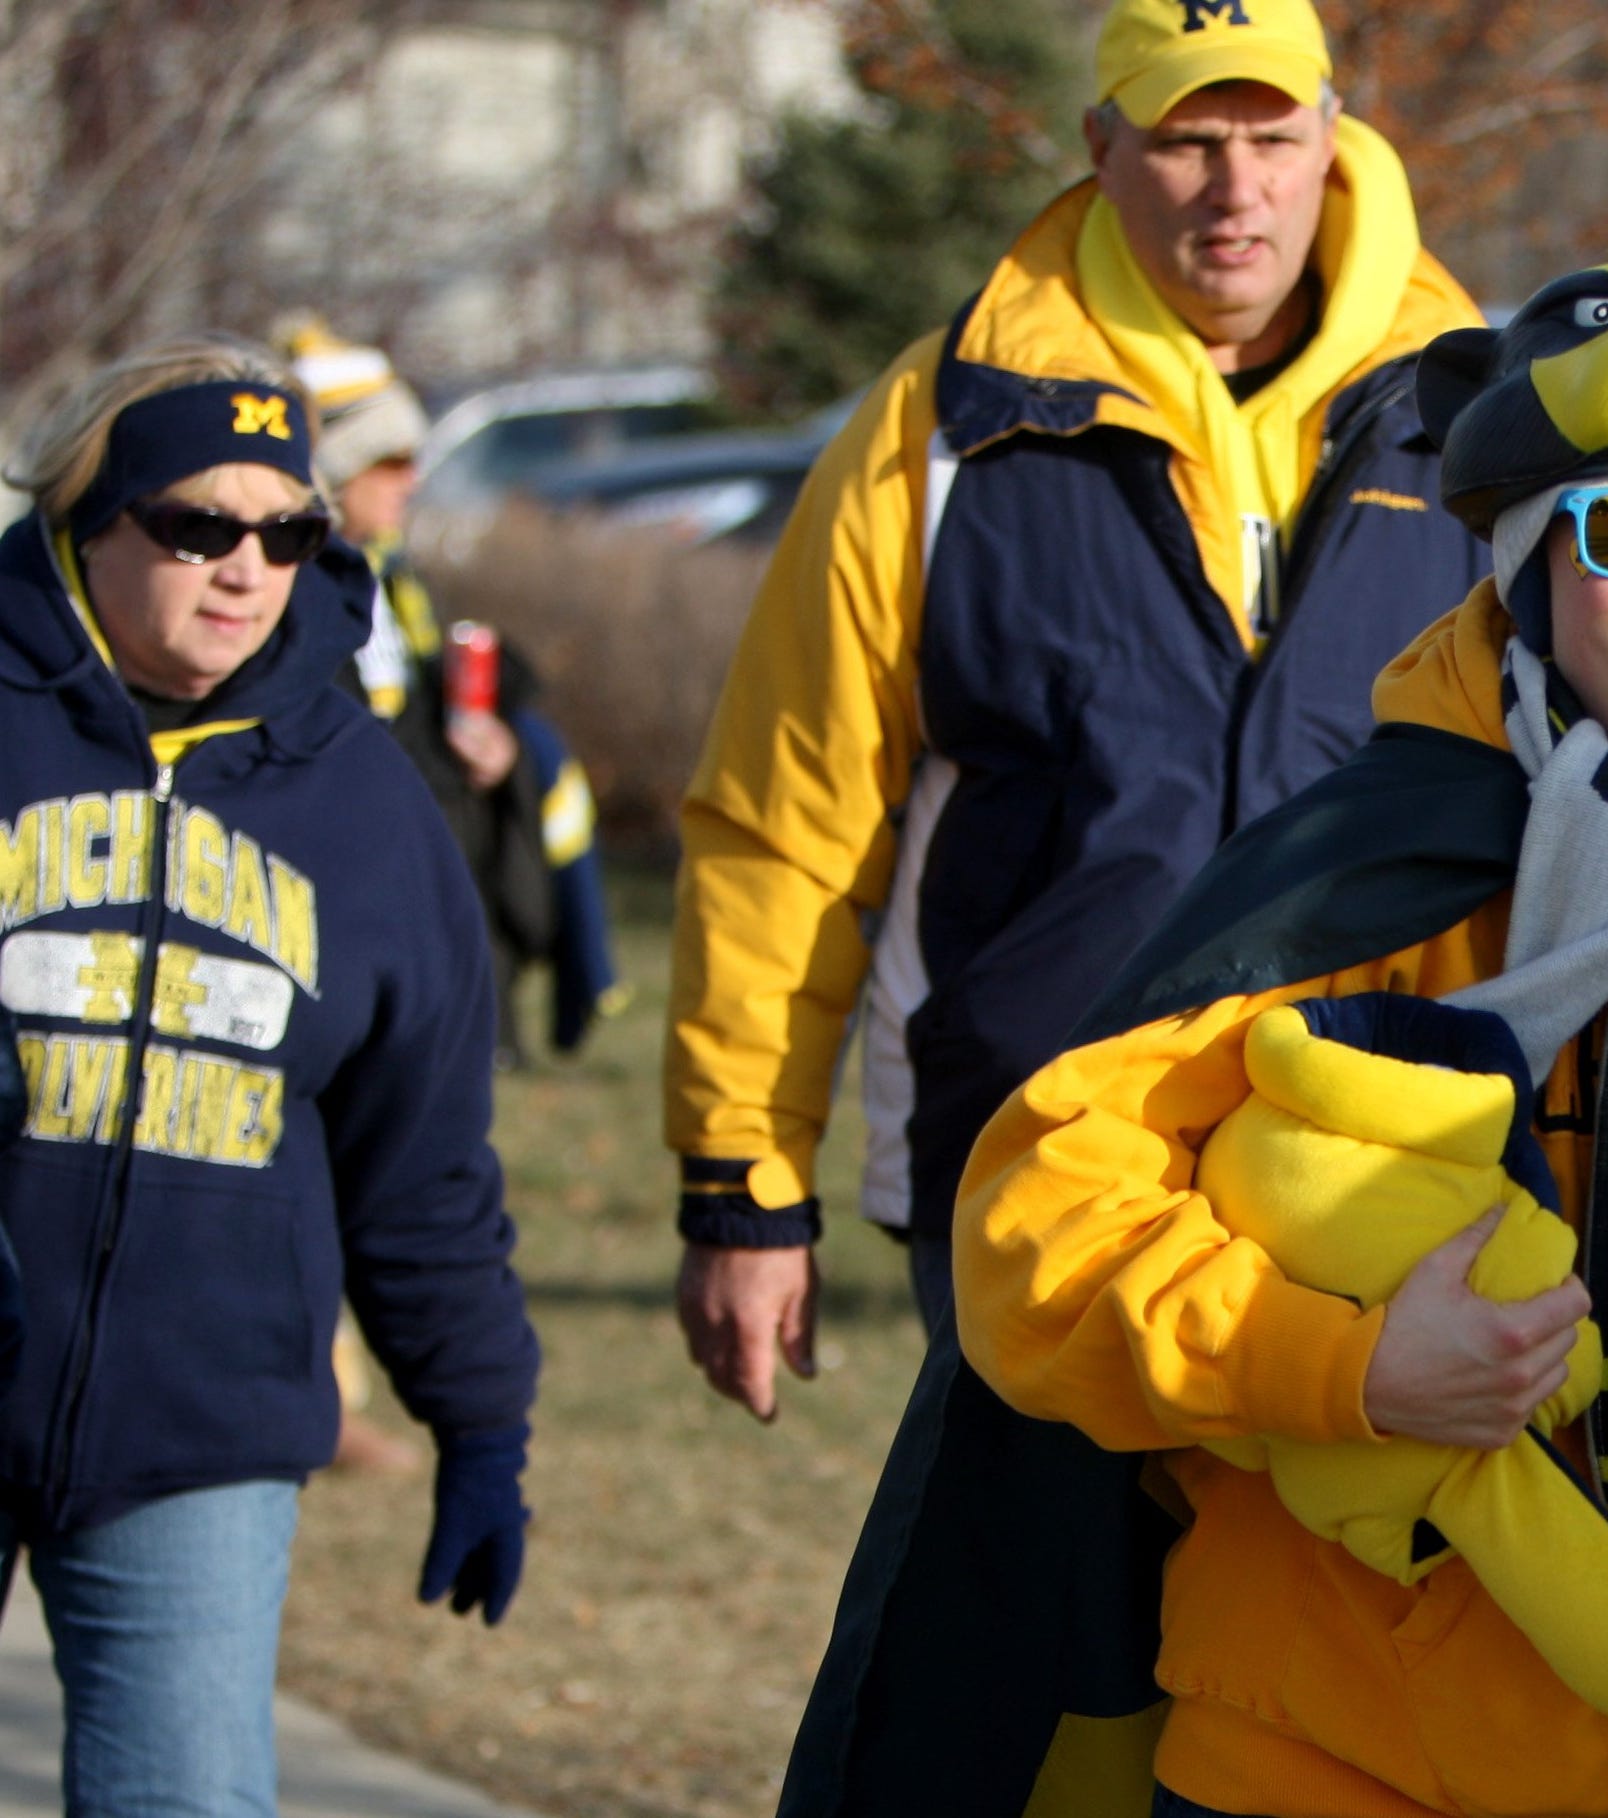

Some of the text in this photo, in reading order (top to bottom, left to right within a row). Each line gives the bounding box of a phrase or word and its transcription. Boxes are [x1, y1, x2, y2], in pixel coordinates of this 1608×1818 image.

[1181, 0, 1251, 34] M
[230, 391, 294, 441] M
[0, 788, 321, 1001] MICHIGAN
[17, 1030, 285, 1169] OLVERINES
